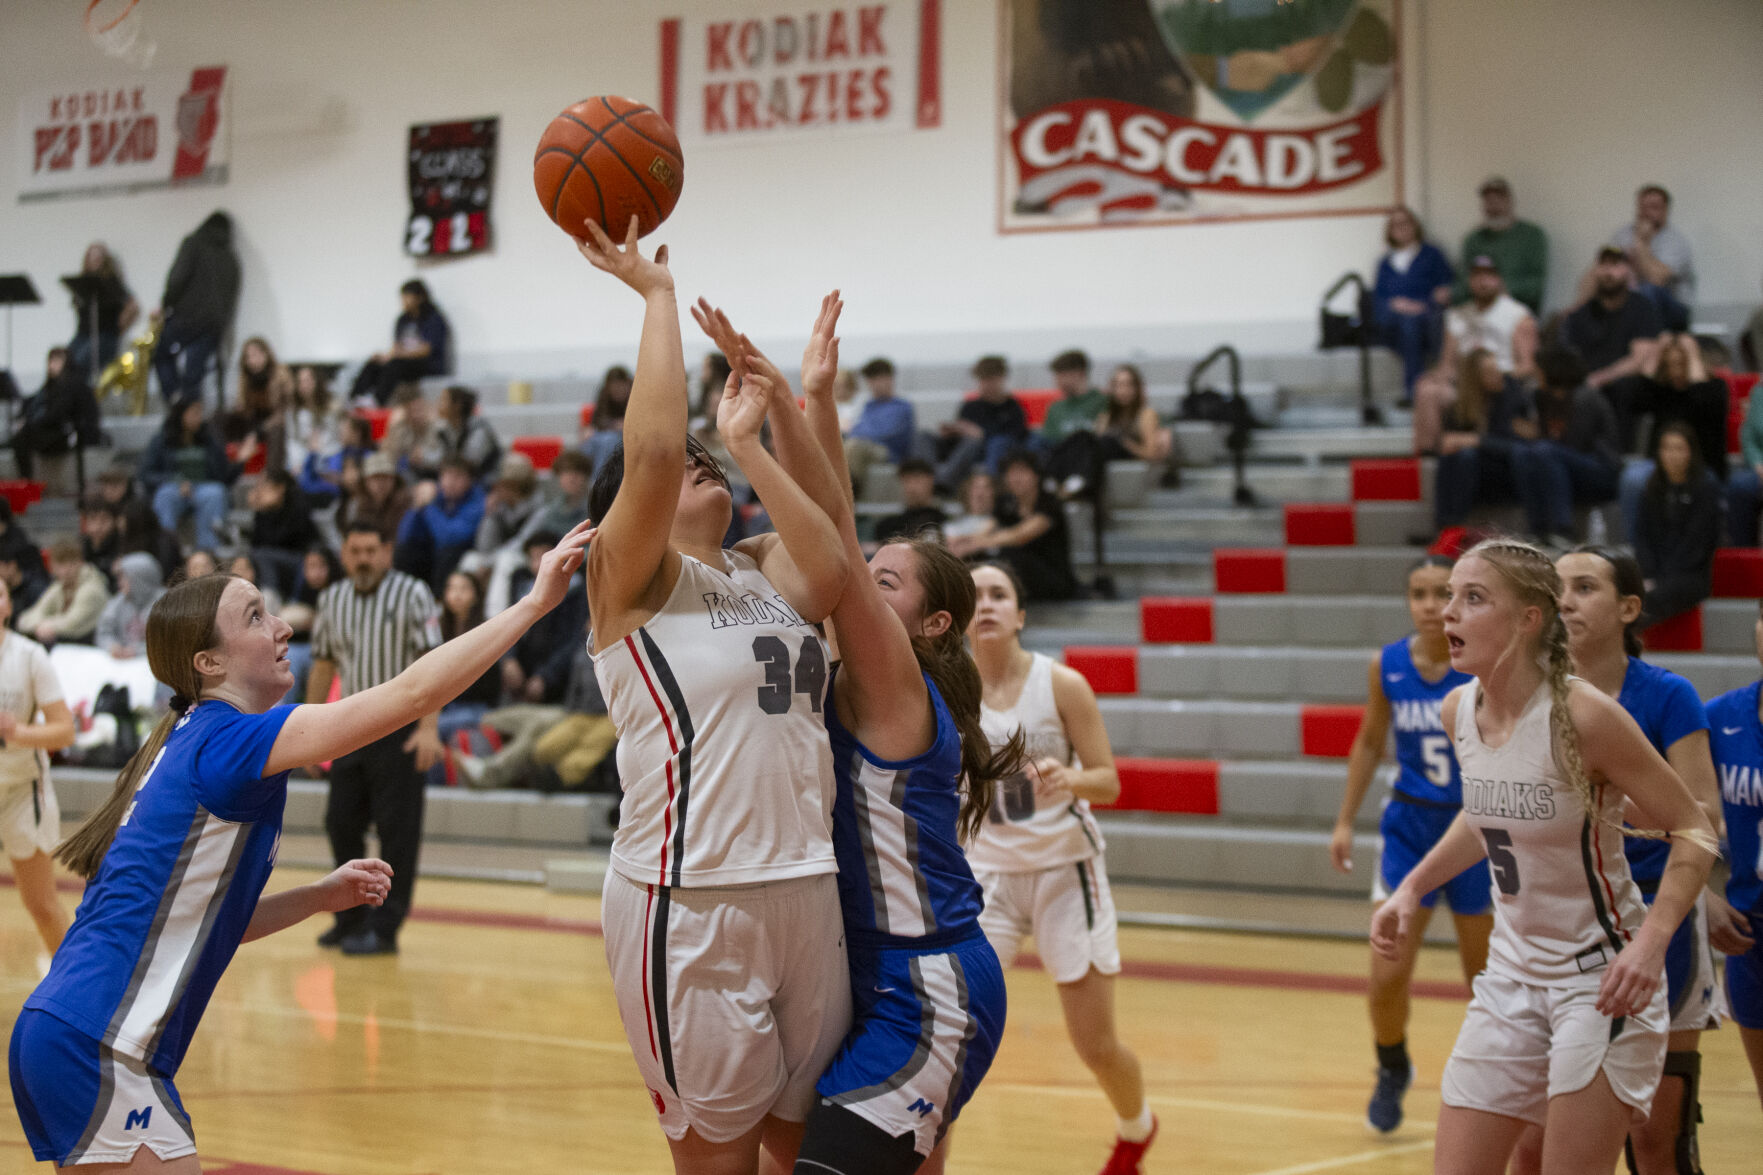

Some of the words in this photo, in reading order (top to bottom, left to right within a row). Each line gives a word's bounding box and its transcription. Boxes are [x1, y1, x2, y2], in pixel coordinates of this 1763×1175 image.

[706, 5, 887, 73] KODIAK
[50, 86, 145, 121] KODIAK
[1020, 109, 1365, 189] CASCADE
[752, 635, 826, 715] 34
[1422, 736, 1451, 788] 5
[1480, 827, 1521, 897] 5
[124, 1105, 153, 1131] M
[905, 1097, 935, 1119] M
